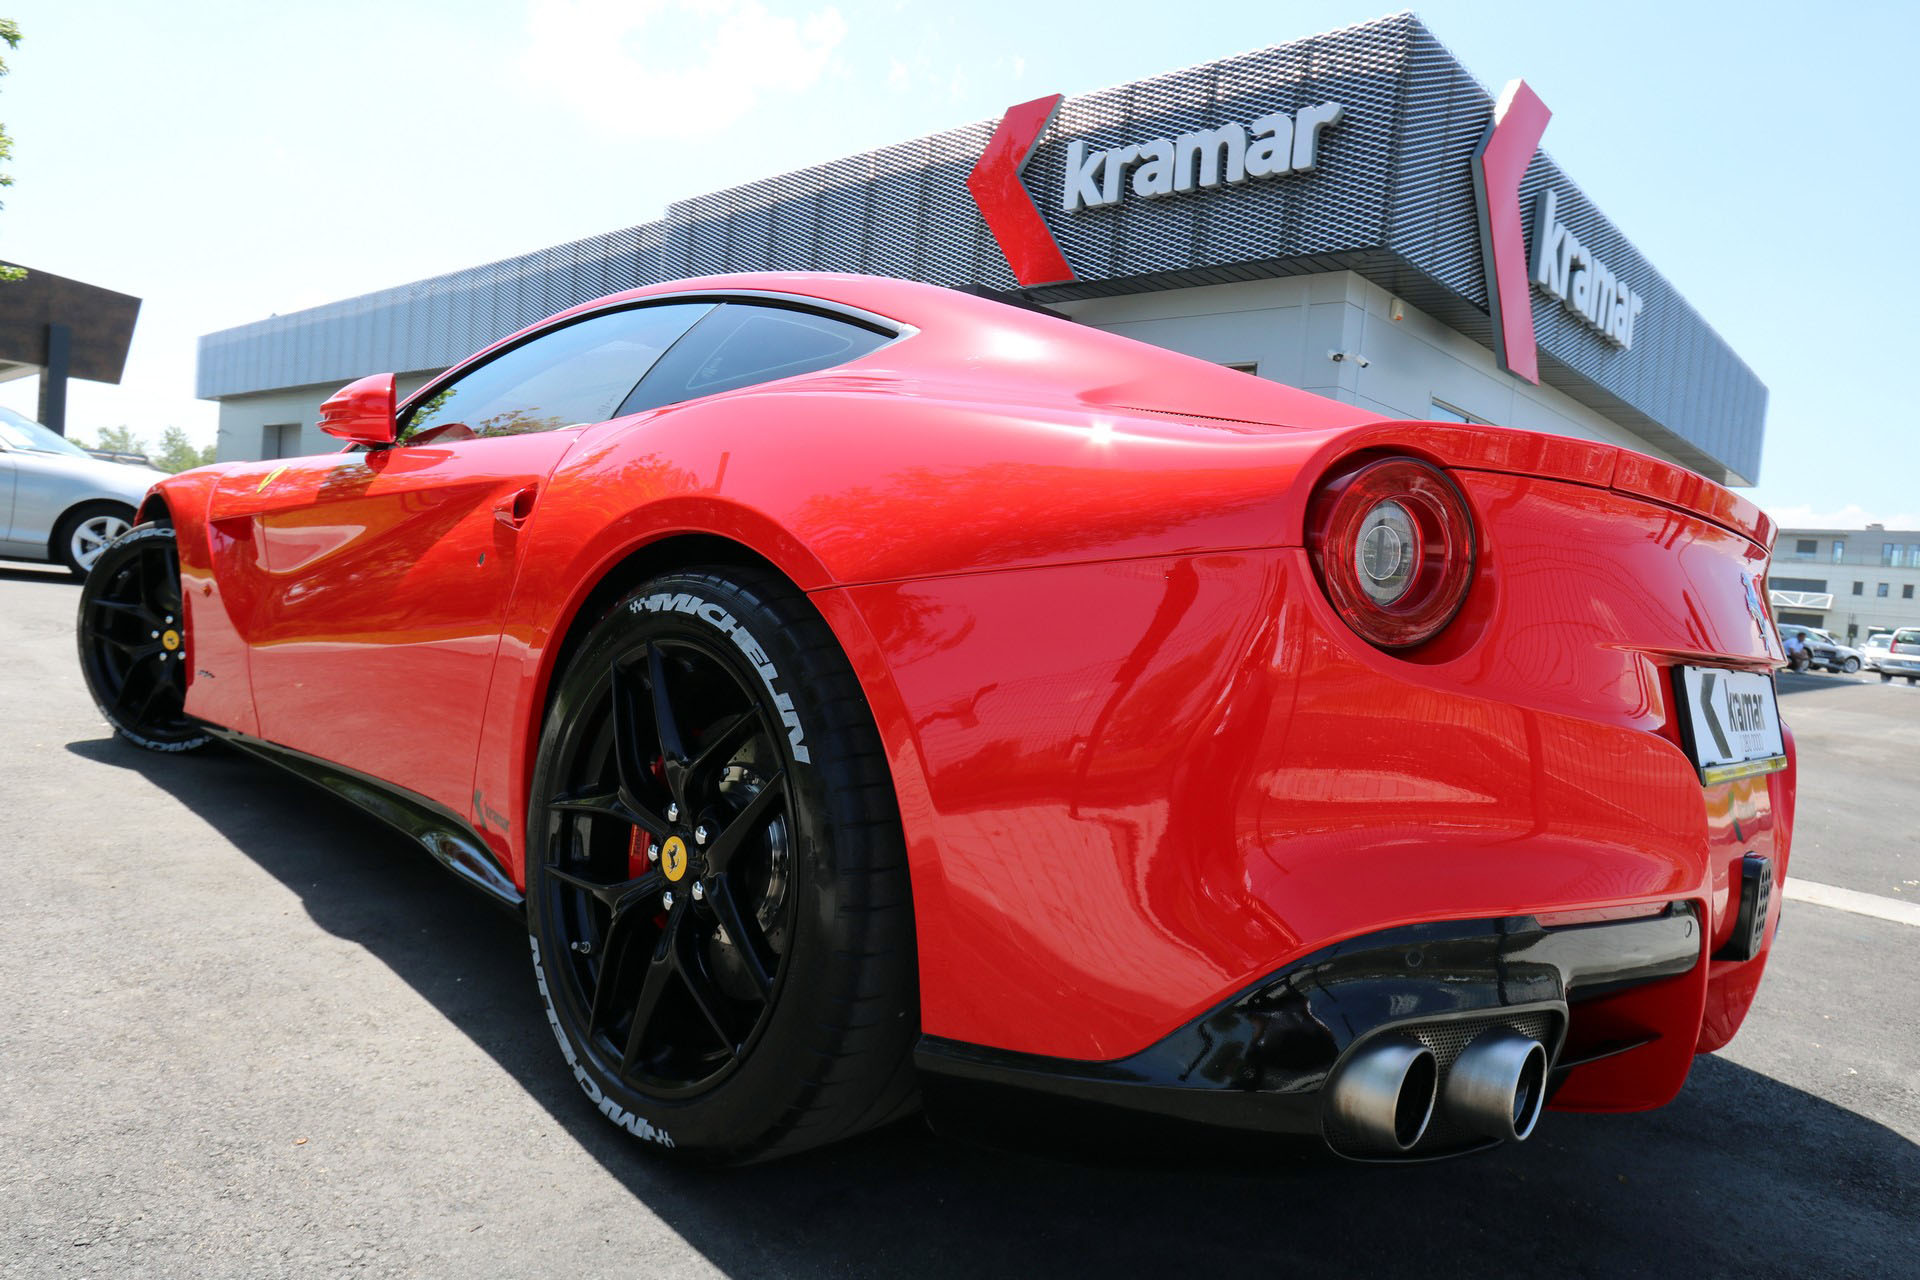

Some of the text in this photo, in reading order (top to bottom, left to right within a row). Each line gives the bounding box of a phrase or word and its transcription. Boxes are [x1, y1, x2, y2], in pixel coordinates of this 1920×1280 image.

[1063, 101, 1345, 212] kramar
[1530, 189, 1643, 350] kramar
[637, 593, 811, 764] MICHELIN
[1724, 679, 1766, 732] kramar
[529, 934, 662, 1142] MICHELIN
